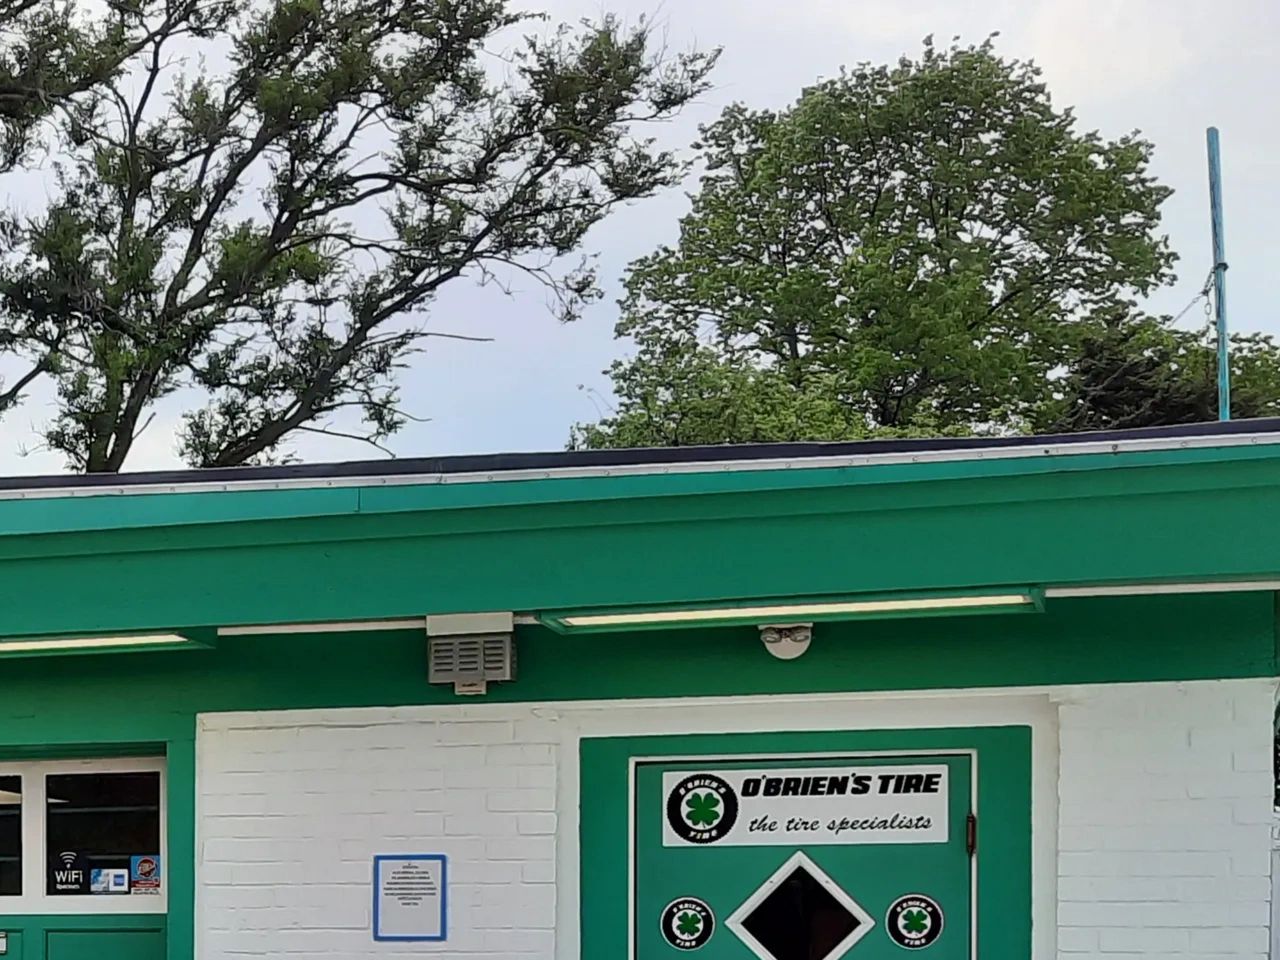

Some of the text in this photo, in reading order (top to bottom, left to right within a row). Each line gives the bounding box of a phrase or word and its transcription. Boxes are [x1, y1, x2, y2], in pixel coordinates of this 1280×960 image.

[740, 773, 943, 797] O'BRIEN'S TIRE
[748, 813, 933, 836] the tire specialists
